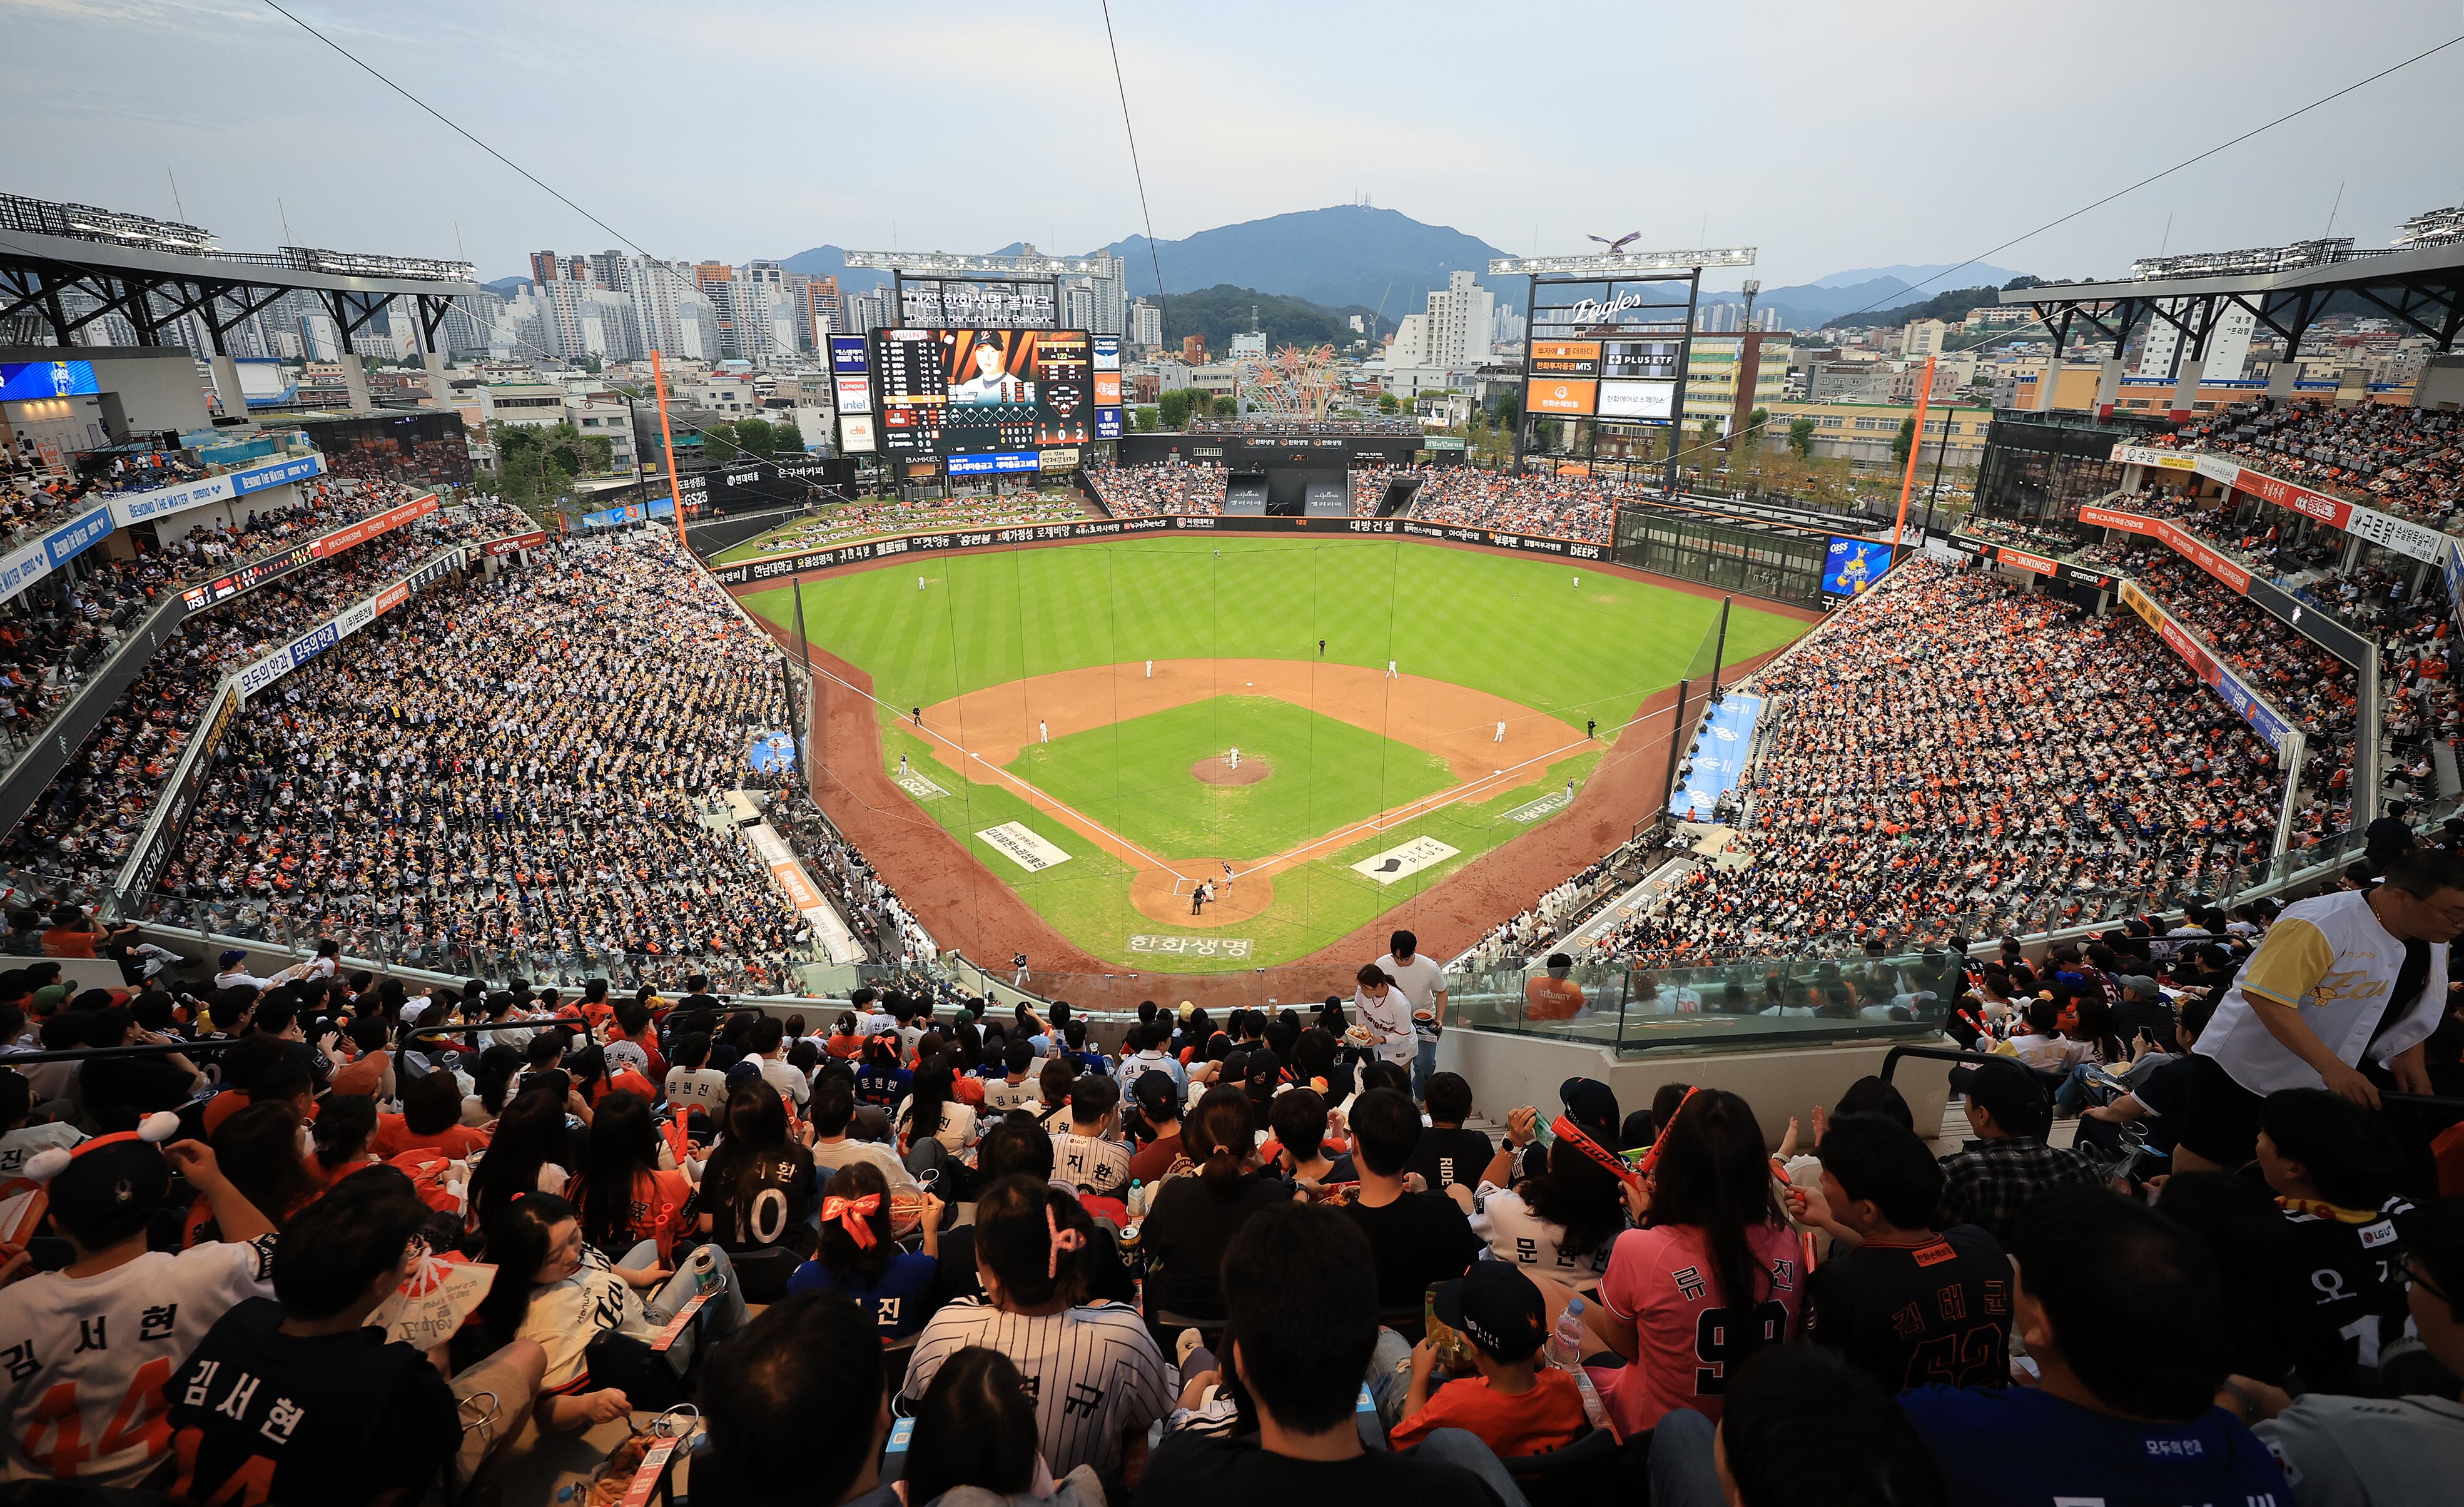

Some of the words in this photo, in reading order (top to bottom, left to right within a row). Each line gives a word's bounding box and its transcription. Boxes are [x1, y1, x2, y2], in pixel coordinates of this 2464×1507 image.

[909, 292, 938, 308] 대전
[943, 293, 1001, 310] 한화생명
[1008, 295, 1050, 310] 볼파크
[1571, 290, 1641, 323] Eagles
[910, 314, 945, 323] Daejeon
[948, 314, 988, 323] Hanwha
[991, 314, 1009, 323] Life
[1013, 315, 1051, 323] Ballpark
[1573, 347, 1593, 356] 더하다
[1625, 355, 1650, 364] PLUS
[1653, 355, 1673, 364] ETF
[844, 400, 866, 409] intel
[1542, 400, 1579, 408] 한화손해보험
[1607, 395, 1665, 404] 한화에어로스페이스
[1041, 430, 1047, 441] 1
[1058, 429, 1066, 440] 0
[1076, 429, 1083, 440] 2
[906, 455, 940, 464] BAMKEL
[950, 462, 993, 472] MG새마을금고
[242, 474, 261, 489] BEYOND
[260, 473, 270, 486] THE
[269, 469, 285, 484] WATER
[288, 465, 301, 475] arena
[777, 466, 824, 479] 은구비커피
[678, 476, 706, 489] 도표성경김
[128, 502, 155, 517] BEYOND
[156, 497, 168, 510] THE
[166, 494, 189, 509] WATER
[193, 488, 210, 500] arena
[684, 491, 708, 506] GS25
[1037, 525, 1071, 538] 로제비앙
[1350, 520, 1394, 532] 대방건설
[2362, 514, 2396, 545] 구르닭
[1494, 534, 1518, 548] 부루펜
[1959, 539, 1981, 552] aramark
[1570, 545, 1600, 559] DEEPS
[753, 560, 794, 577] 한남대학교
[2017, 555, 2052, 572] INNINGS
[410, 553, 459, 592] 청주하나병원
[2071, 570, 2099, 584] aramark
[345, 604, 373, 630] (주)보은건설
[294, 634, 318, 662] 모두의
[317, 626, 335, 649] 안과
[241, 661, 270, 693] 모두의
[269, 653, 290, 676] 안과
[898, 778, 932, 796] GS25
[150, 834, 167, 870] PLAY
[1399, 841, 1436, 860] LIFE
[1409, 845, 1445, 864] PLUS
[1130, 935, 1248, 956] 한화생명
[1539, 990, 1571, 1000] SECURITY
[669, 1081, 709, 1097] 류현진
[860, 1077, 896, 1092] 문현빈
[1067, 1155, 1112, 1182] 지환
[1672, 1257, 1794, 1301] 류진
[577, 1287, 591, 1324] Hanwha
[1892, 1281, 2008, 1340] 김태균
[0, 1303, 178, 1383] 김서현
[184, 1359, 305, 1445] 김서현
[21, 1356, 171, 1480] 44
[2146, 1440, 2181, 1456] 모두의
[2182, 1439, 2203, 1455] 안과
